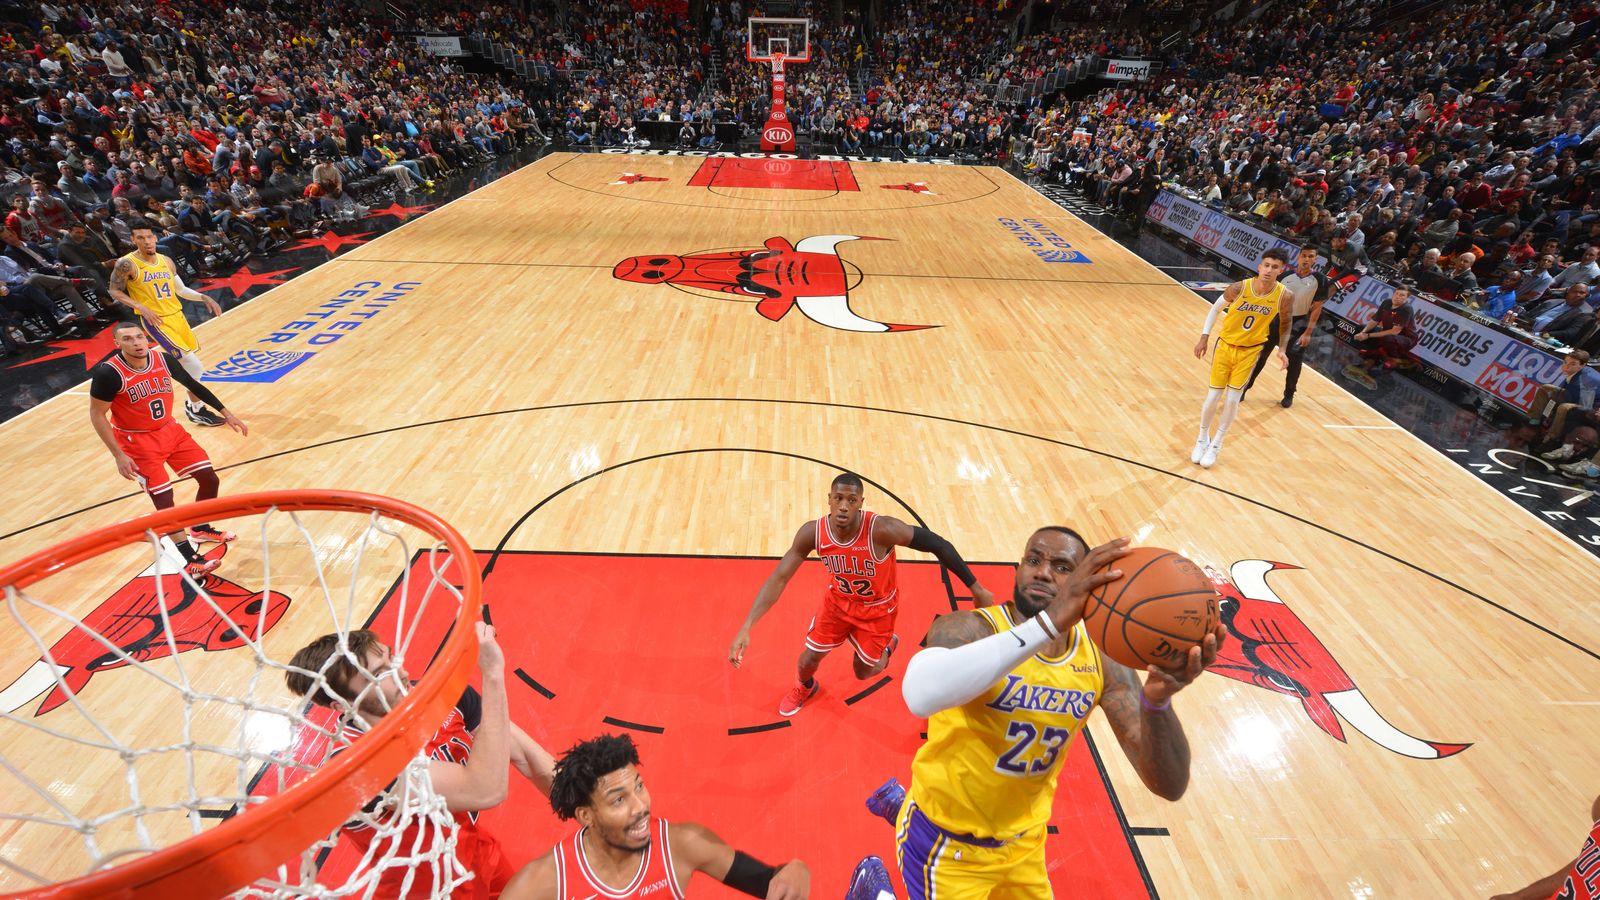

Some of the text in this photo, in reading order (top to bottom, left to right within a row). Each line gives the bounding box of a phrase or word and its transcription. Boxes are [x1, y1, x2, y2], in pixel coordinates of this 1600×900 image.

[1115, 62, 1148, 77] impact
[769, 131, 787, 141] KIA
[1168, 212, 1196, 231] ADDITIVES
[1171, 201, 1203, 222] MOTOR OILS
[1205, 211, 1231, 233] LIQUI
[997, 217, 1044, 247] CENTER
[1023, 218, 1072, 249] UNITED
[1196, 226, 1221, 249] MOLY
[1228, 227, 1269, 251] MOTOR OILS
[1223, 239, 1260, 262] ADDITIVES
[143, 271, 171, 282] LAKERS
[153, 282, 172, 299] 14
[257, 281, 382, 343] CENTER
[307, 281, 422, 345] UNITED
[1236, 300, 1273, 316] LAKERS
[1242, 315, 1256, 331] 0
[1413, 308, 1494, 355] MOTOR OILS
[1416, 329, 1476, 367] DDITIVES
[126, 376, 172, 404] BULLS
[1479, 366, 1537, 407] MOL
[148, 397, 166, 421] 8
[834, 575, 874, 597] 32
[985, 673, 1097, 720] LAKERS
[994, 720, 1070, 777] 23
